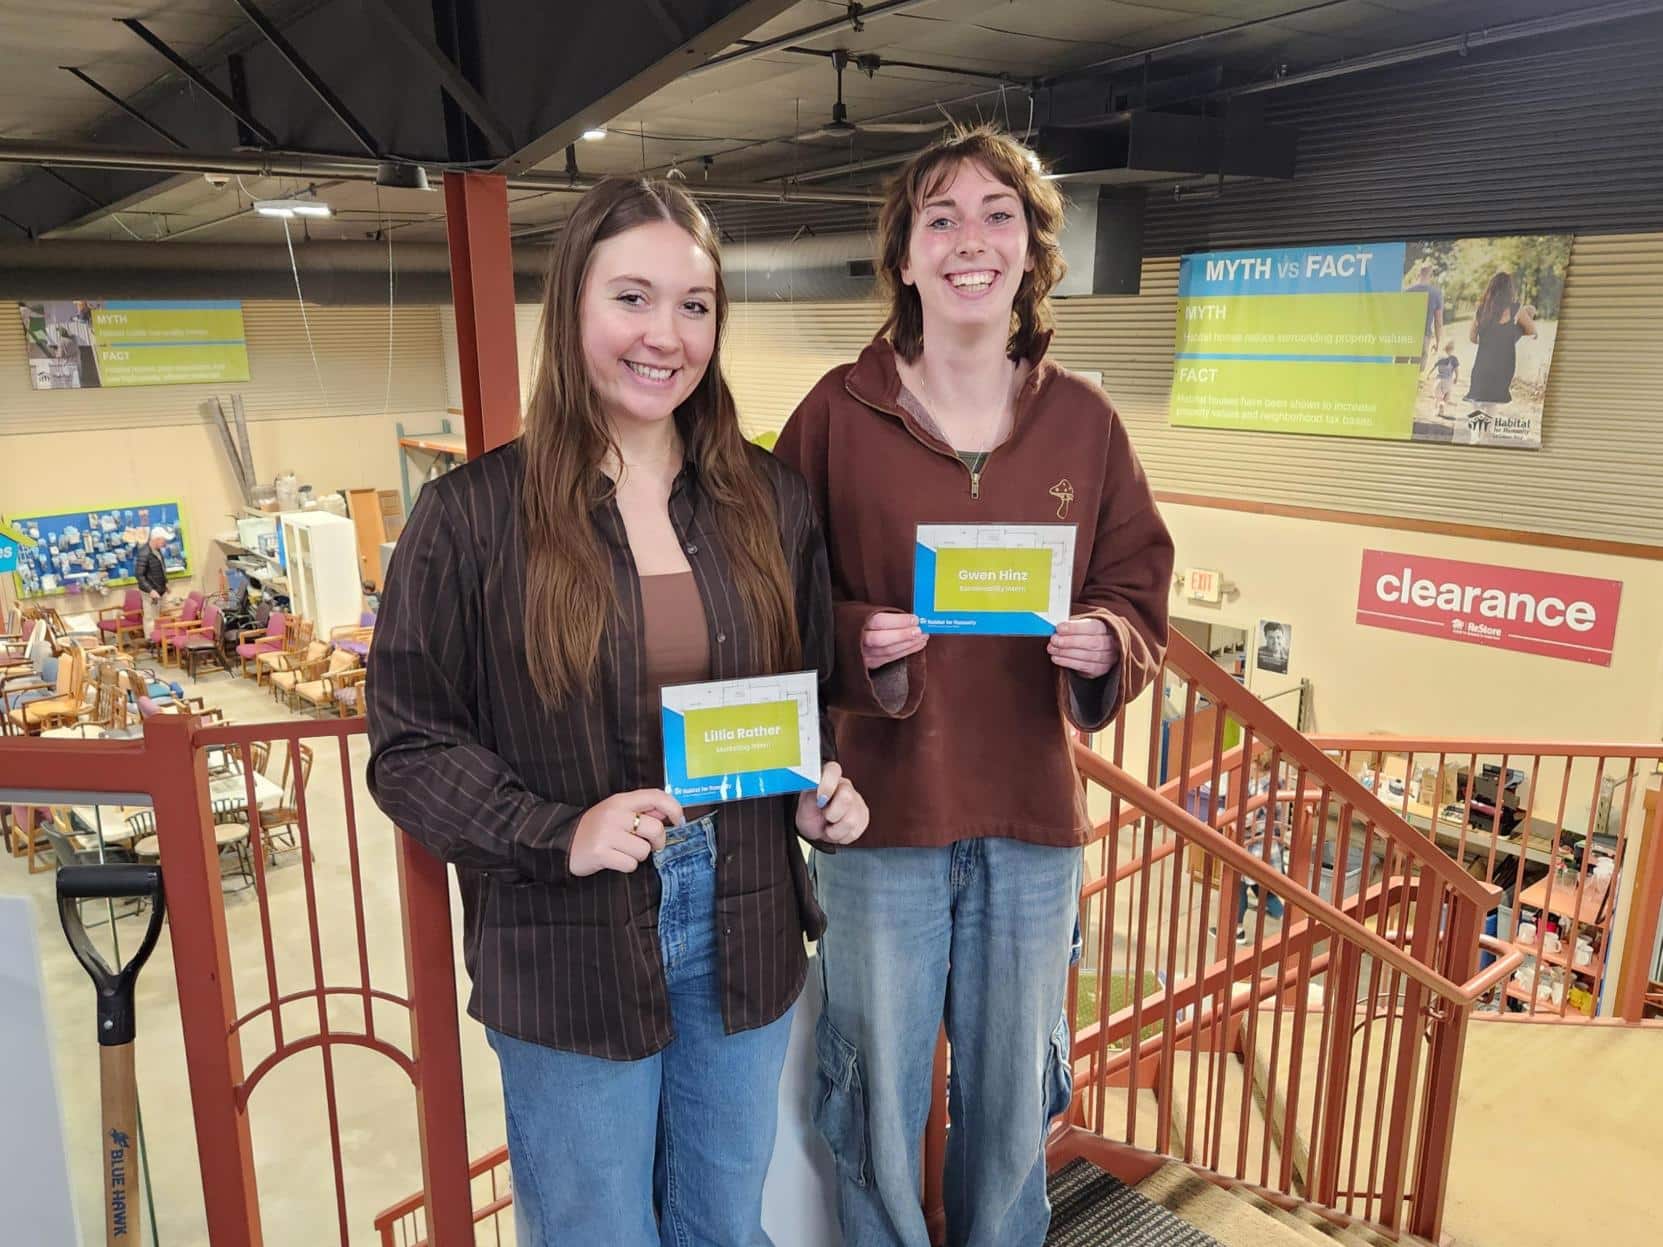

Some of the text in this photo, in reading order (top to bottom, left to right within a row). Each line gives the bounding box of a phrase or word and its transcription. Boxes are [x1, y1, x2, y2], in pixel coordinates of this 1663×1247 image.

[1206, 257, 1272, 281] MYTH
[1305, 253, 1373, 278] FACT
[96, 314, 128, 325] MYTH
[1185, 304, 1227, 321] MYTH
[1278, 333, 1333, 345] surrounding
[1335, 334, 1377, 345] property
[103, 351, 129, 361] FACT
[1179, 367, 1218, 383] FACT
[1291, 399, 1321, 410] shown
[1323, 400, 1333, 410] to
[1260, 411, 1324, 424] neighborhood
[1326, 414, 1339, 424] tax
[1494, 417, 1530, 428] Habitat
[960, 568, 1028, 581] Gwen Hinz
[1191, 571, 1213, 592] EXIT
[1376, 567, 1596, 632] clearance
[1467, 622, 1502, 637] ReStore
[737, 725, 781, 740] Rather
[111, 1149, 127, 1237] BLUE HAWK
